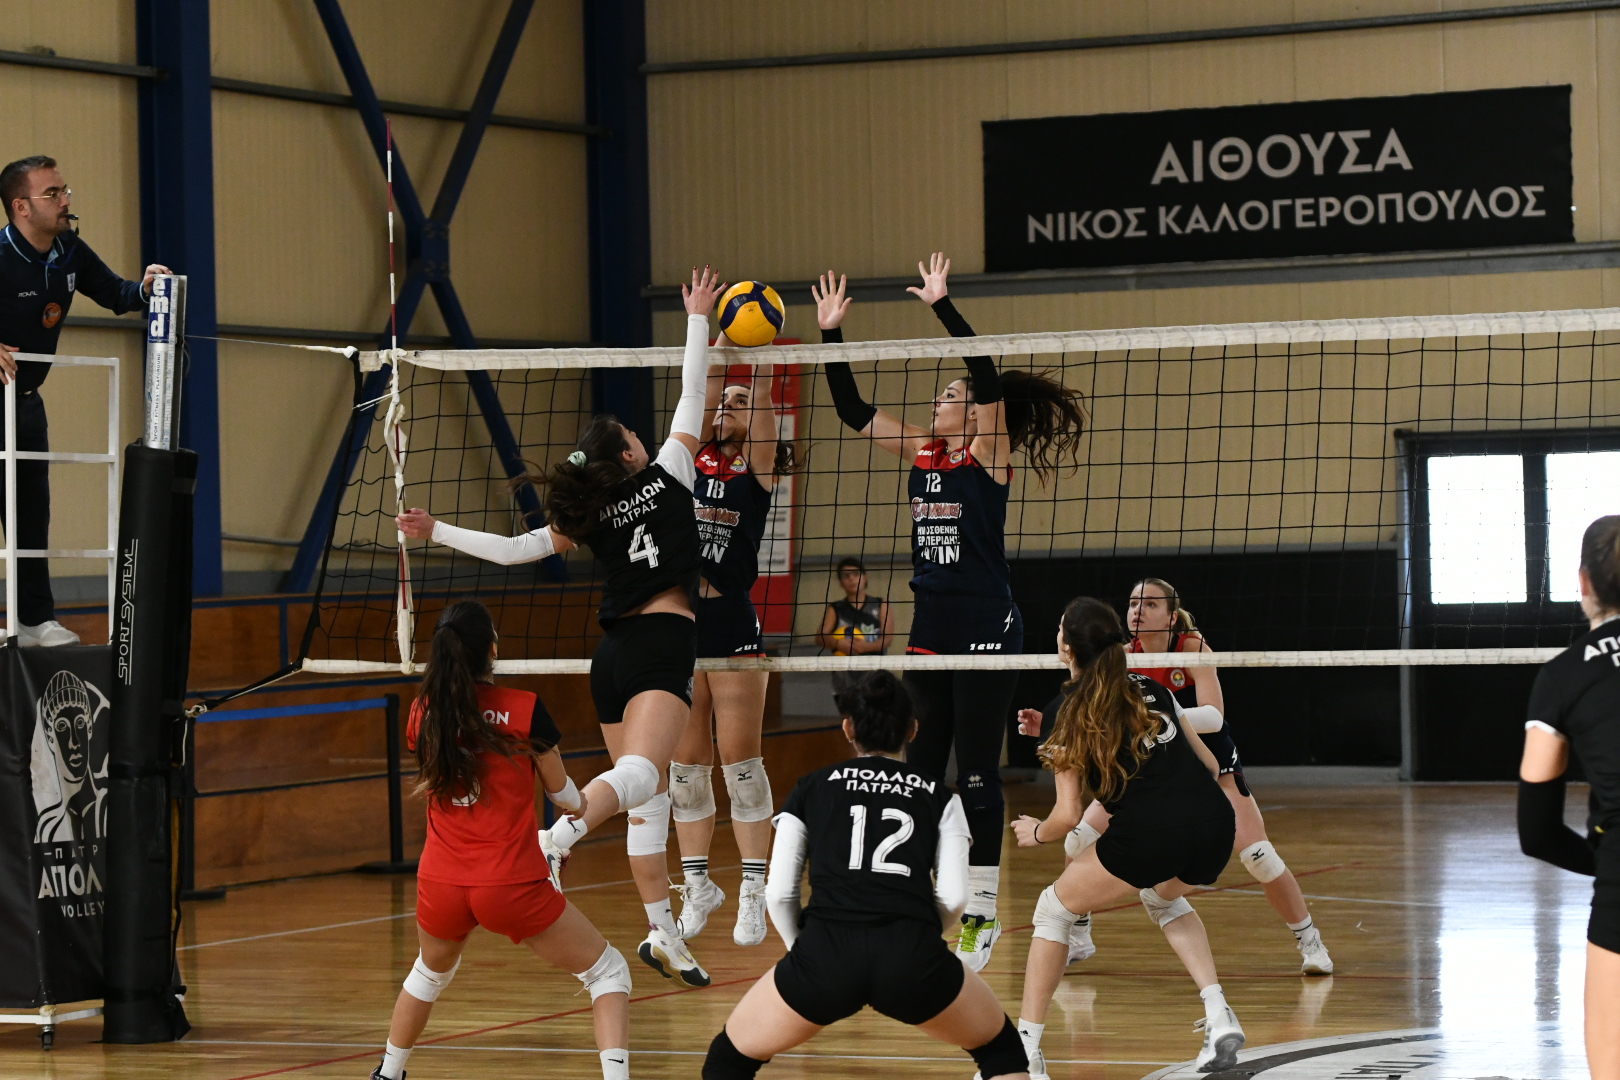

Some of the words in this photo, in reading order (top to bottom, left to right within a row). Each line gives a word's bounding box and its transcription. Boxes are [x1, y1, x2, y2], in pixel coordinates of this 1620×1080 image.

[1150, 127, 1413, 186] ΑΙΘΟΥΣΑ
[1026, 206, 1148, 244] ΝΙΚΟΣ
[1158, 185, 1547, 236] ΚΑΛΟΓΕΡΟΠΟΥΛΟΣ
[150, 278, 169, 337] emd
[599, 477, 667, 522] ΑΠΟΛΛΩΝ
[707, 478, 725, 499] 18
[925, 472, 942, 493] 12
[612, 498, 658, 529] ΠΑΤΡΑΣ
[627, 522, 660, 569] 4
[118, 622, 133, 686] SPORT
[827, 767, 936, 795] ΑΠΟΛΛΩΝ
[846, 779, 914, 798] ΠΑΤΡΑΣ
[55, 844, 99, 859] ΠΑΤΡ
[848, 804, 915, 877] 12
[38, 862, 103, 899] ΑΠΟΛ
